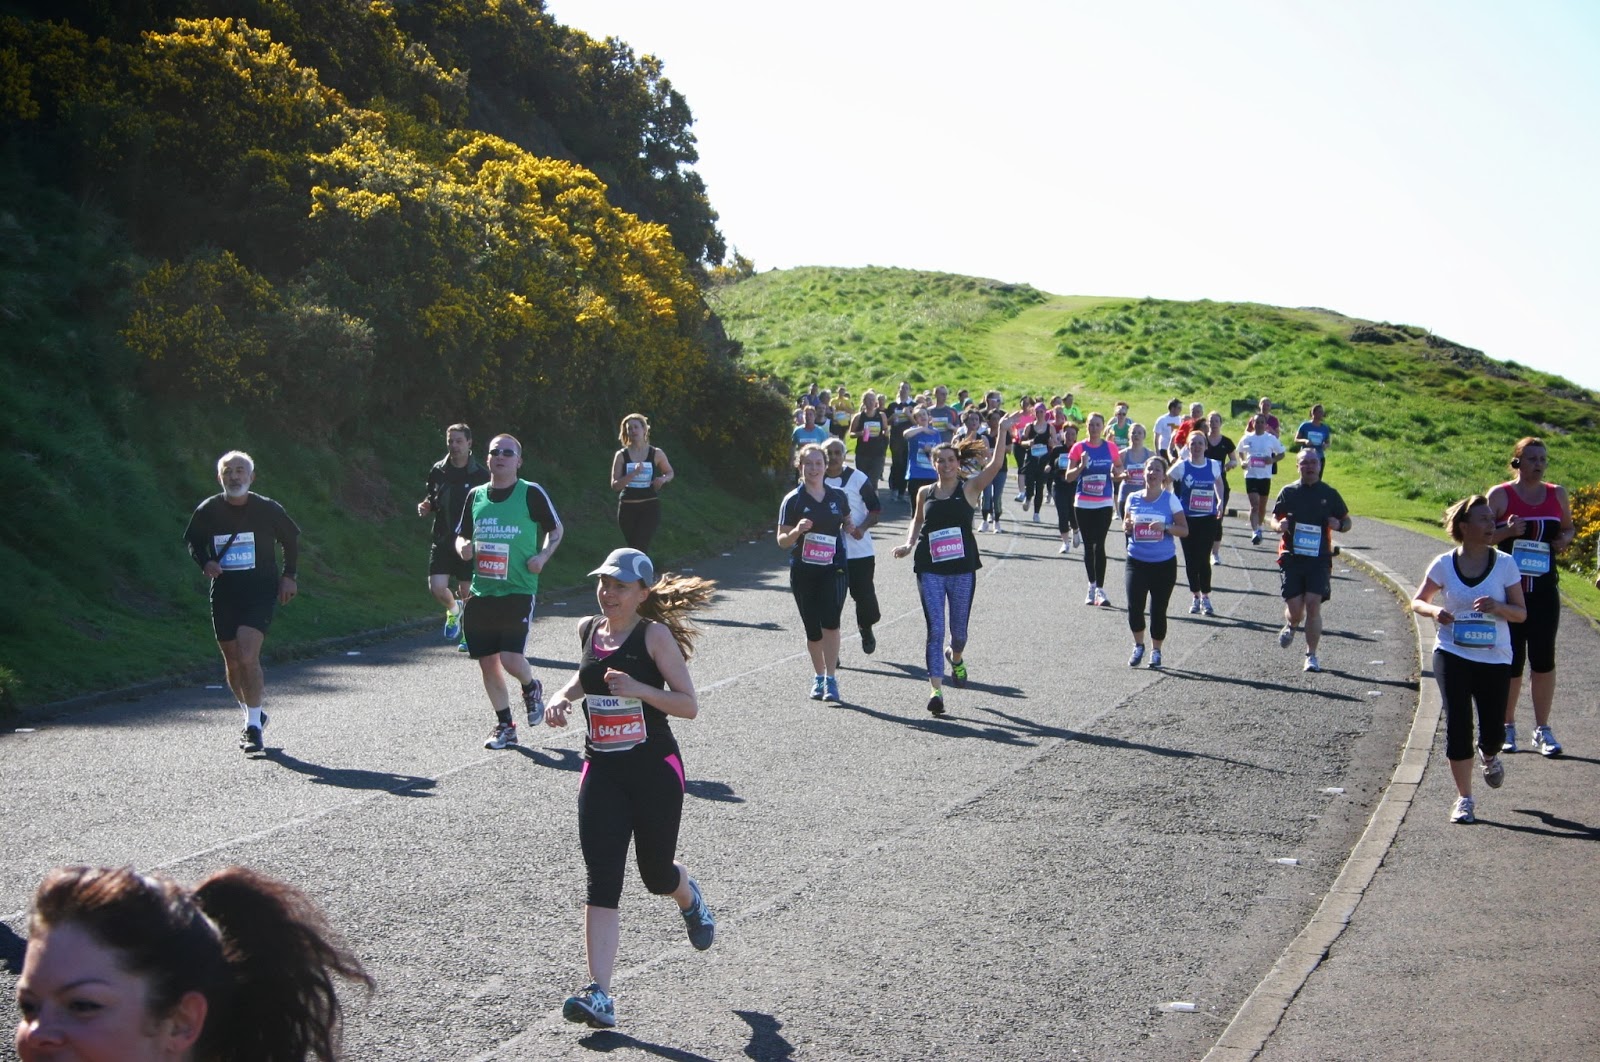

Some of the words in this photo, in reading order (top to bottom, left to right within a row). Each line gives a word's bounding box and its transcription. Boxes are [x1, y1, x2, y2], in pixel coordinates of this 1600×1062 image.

[482, 517, 498, 525] ARE
[479, 560, 505, 571] 64759
[1521, 558, 1547, 569] 63291
[1464, 630, 1494, 640] 63316
[602, 698, 620, 707] 10K
[598, 720, 642, 738] 64722
